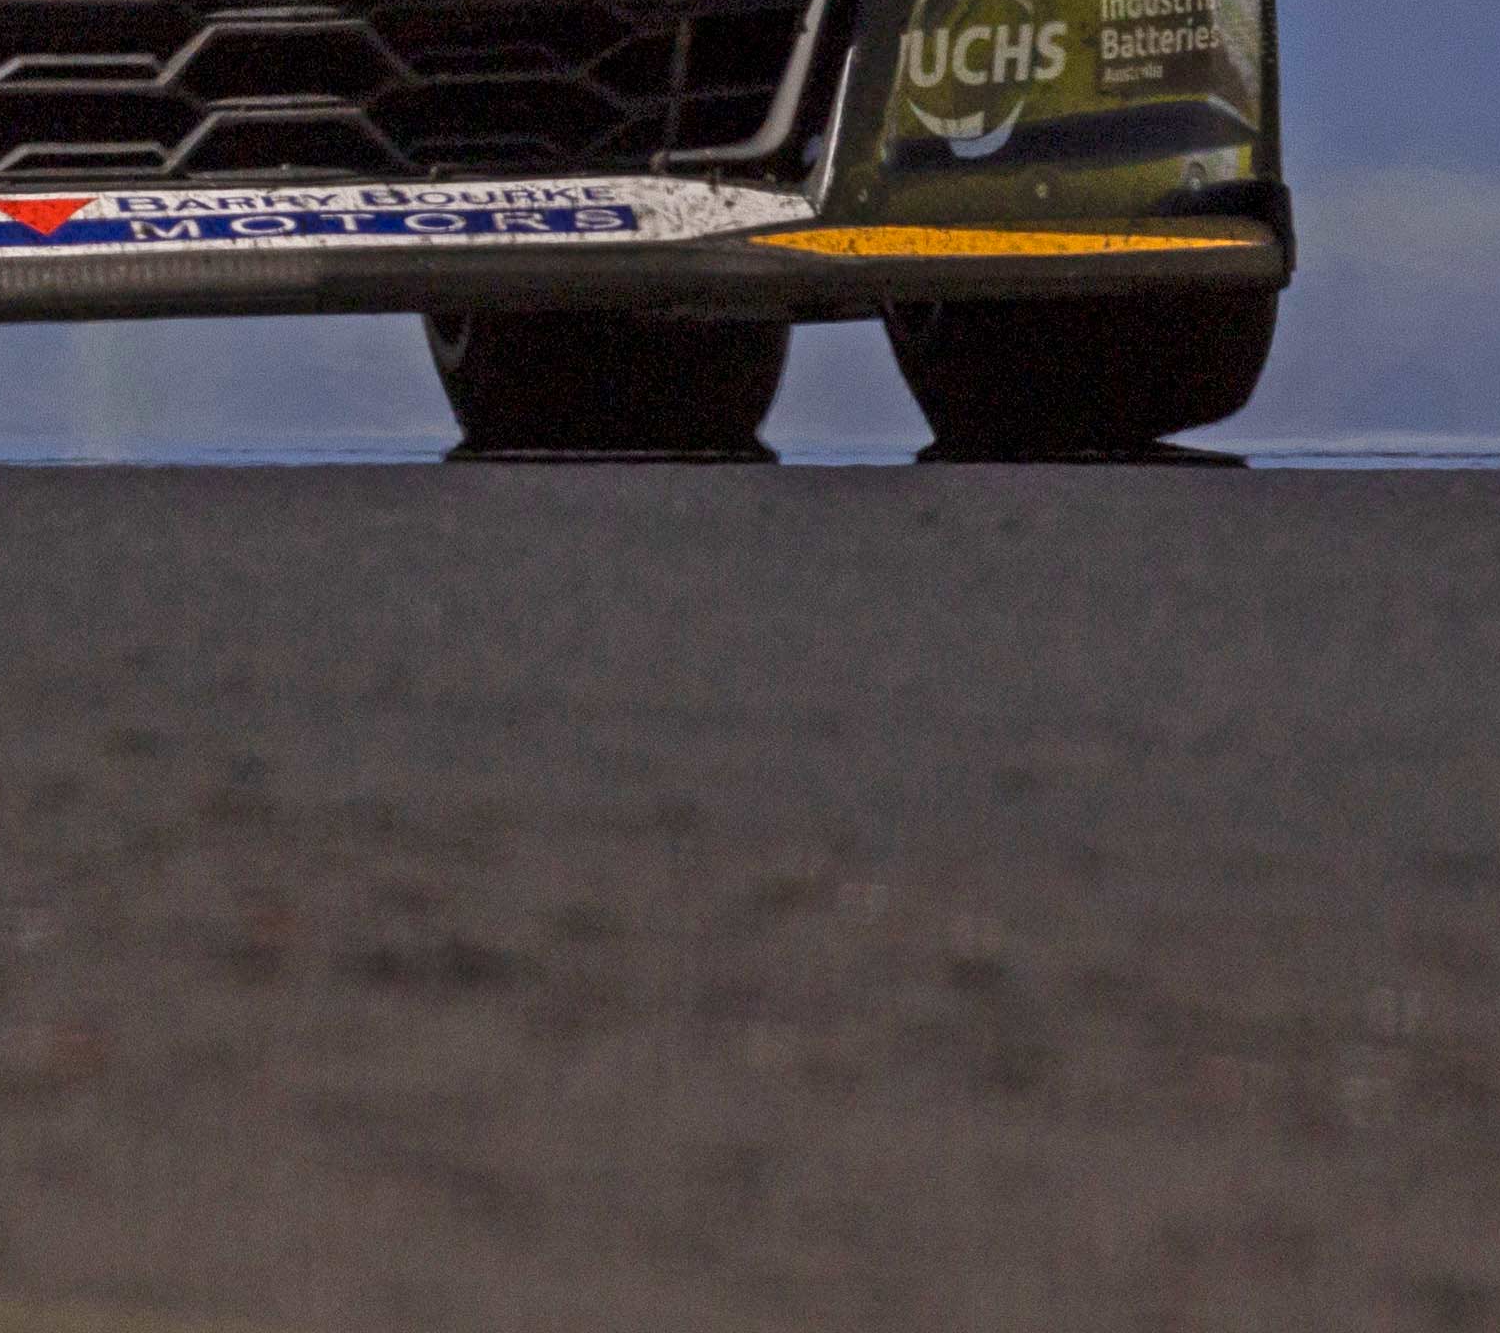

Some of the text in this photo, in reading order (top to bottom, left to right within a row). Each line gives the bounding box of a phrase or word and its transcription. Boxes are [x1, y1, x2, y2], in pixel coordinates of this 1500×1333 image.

[1101, 17, 1221, 60] Batteries
[114, 184, 617, 213] BARRY BOURKE
[129, 205, 624, 241] MOTORS
